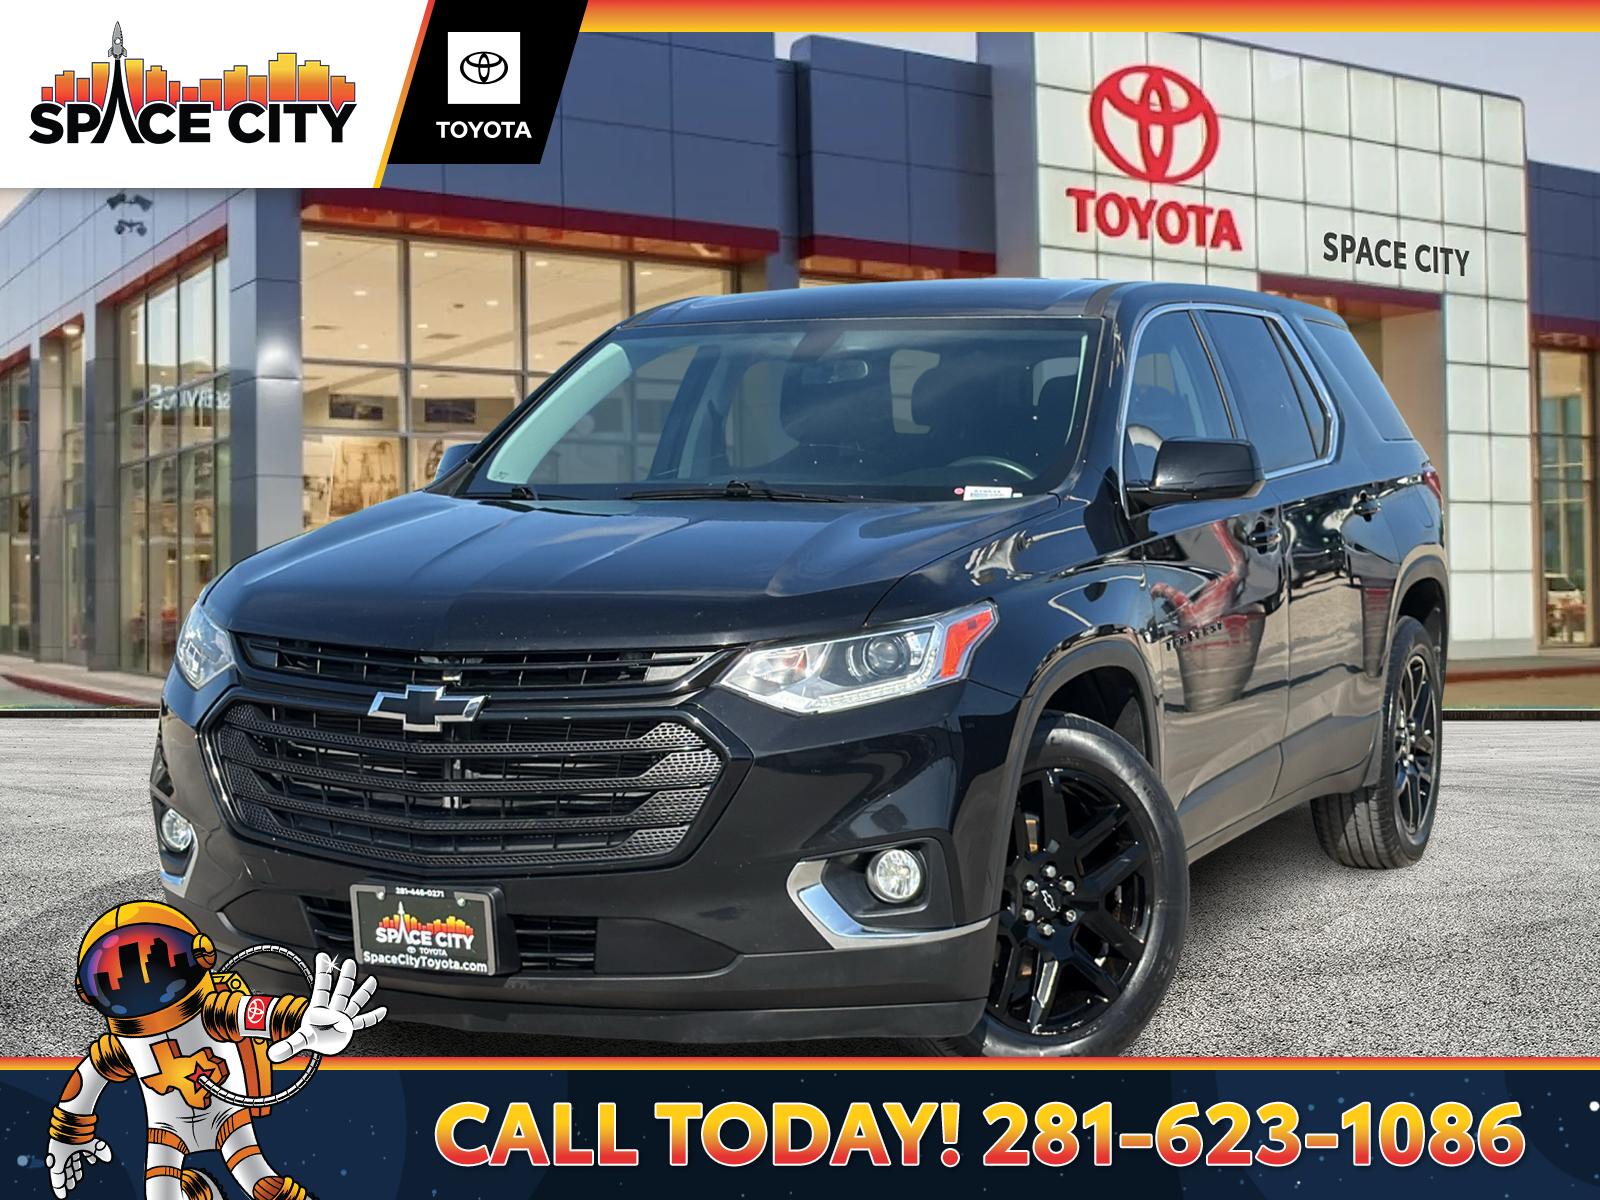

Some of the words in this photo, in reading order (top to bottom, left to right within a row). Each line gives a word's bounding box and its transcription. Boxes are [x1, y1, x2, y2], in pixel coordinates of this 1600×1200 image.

[1066, 188, 1242, 251] TOYOTA
[1323, 231, 1407, 270] SPACE
[1414, 244, 1470, 277] CITY
[376, 921, 432, 945] SPACE
[435, 931, 474, 950] CITY
[363, 951, 488, 973] SpaceCityToyota.com
[418, 946, 447, 957] TOYOTA
